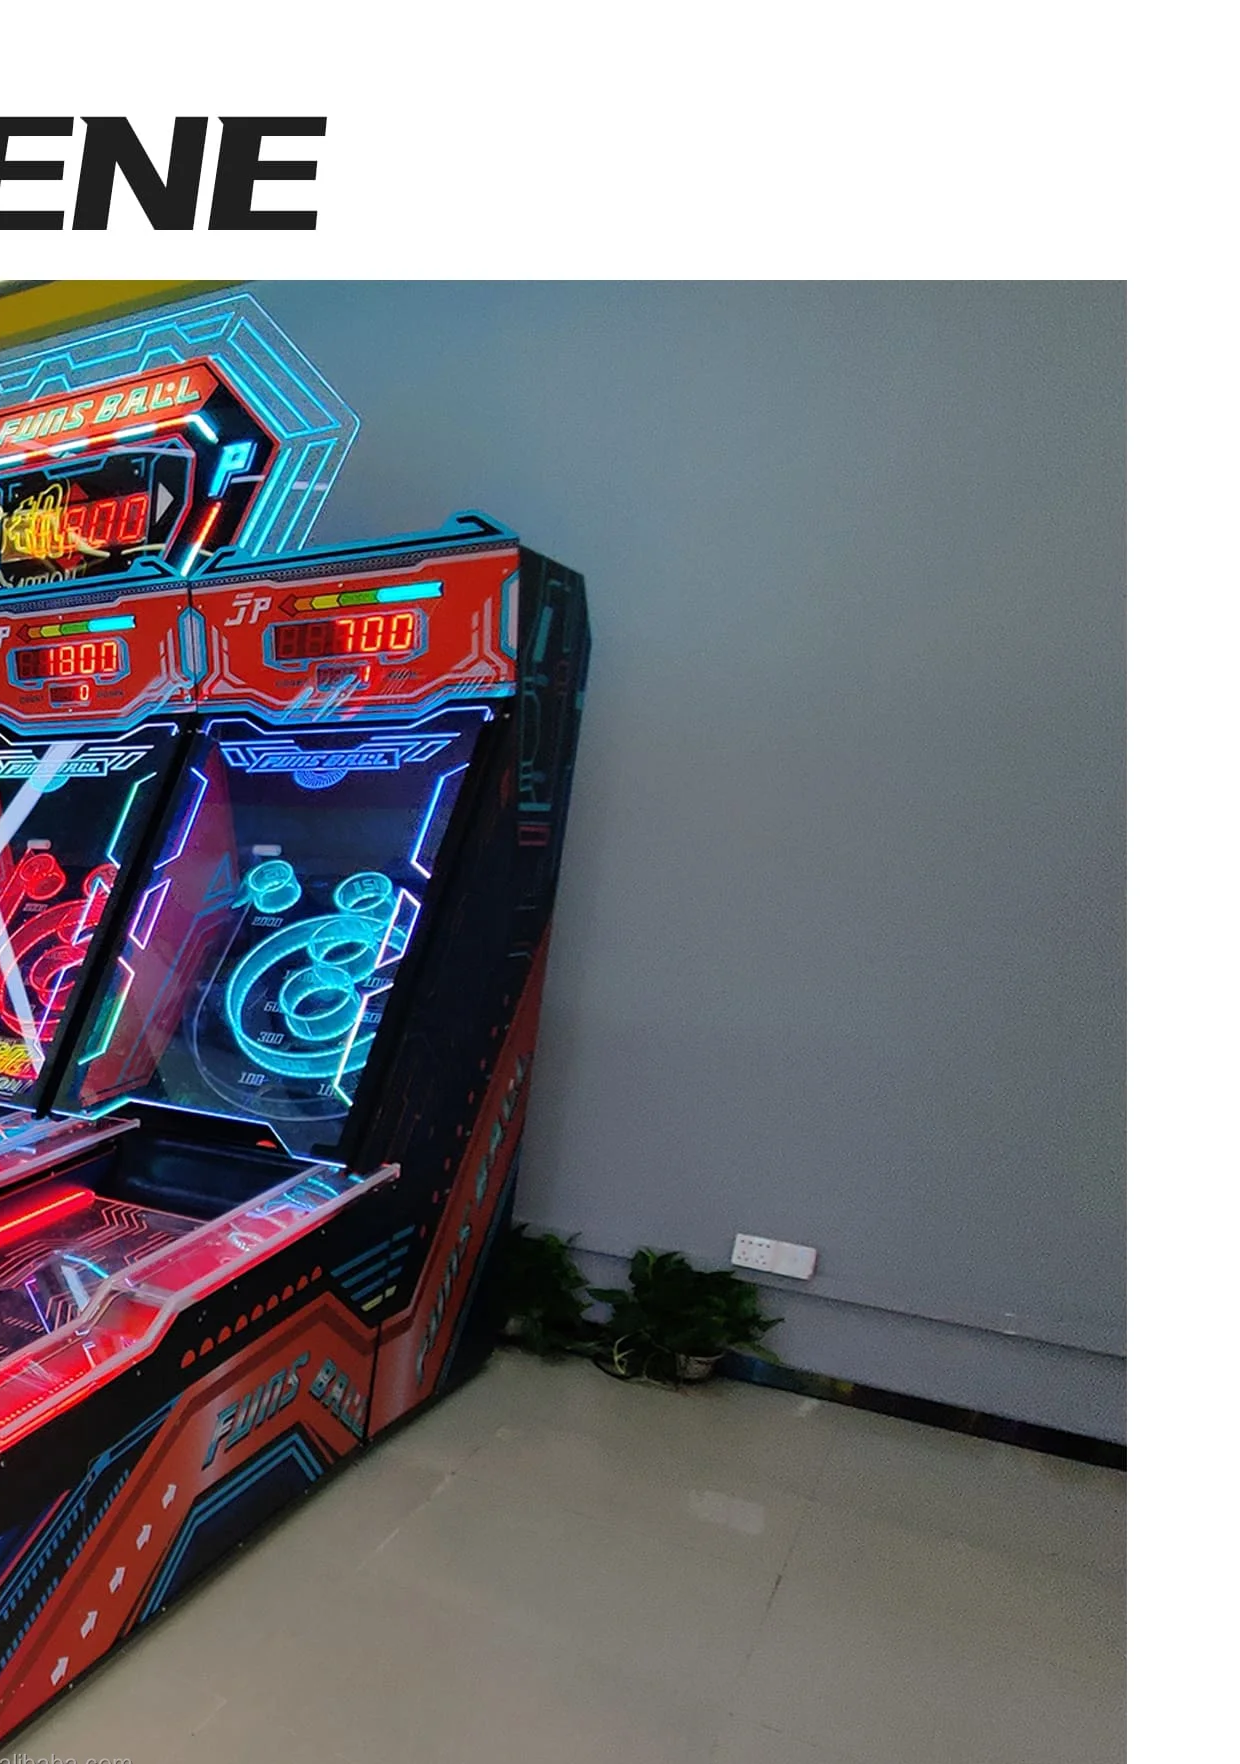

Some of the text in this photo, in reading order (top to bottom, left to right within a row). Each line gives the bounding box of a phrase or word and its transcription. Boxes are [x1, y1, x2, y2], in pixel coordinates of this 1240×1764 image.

[94, 375, 200, 424] BALL
[336, 613, 414, 651] 700
[79, 684, 89, 701] 0
[257, 1031, 285, 1045] 300
[238, 1072, 265, 1087] 100
[201, 1350, 310, 1471] FUNS
